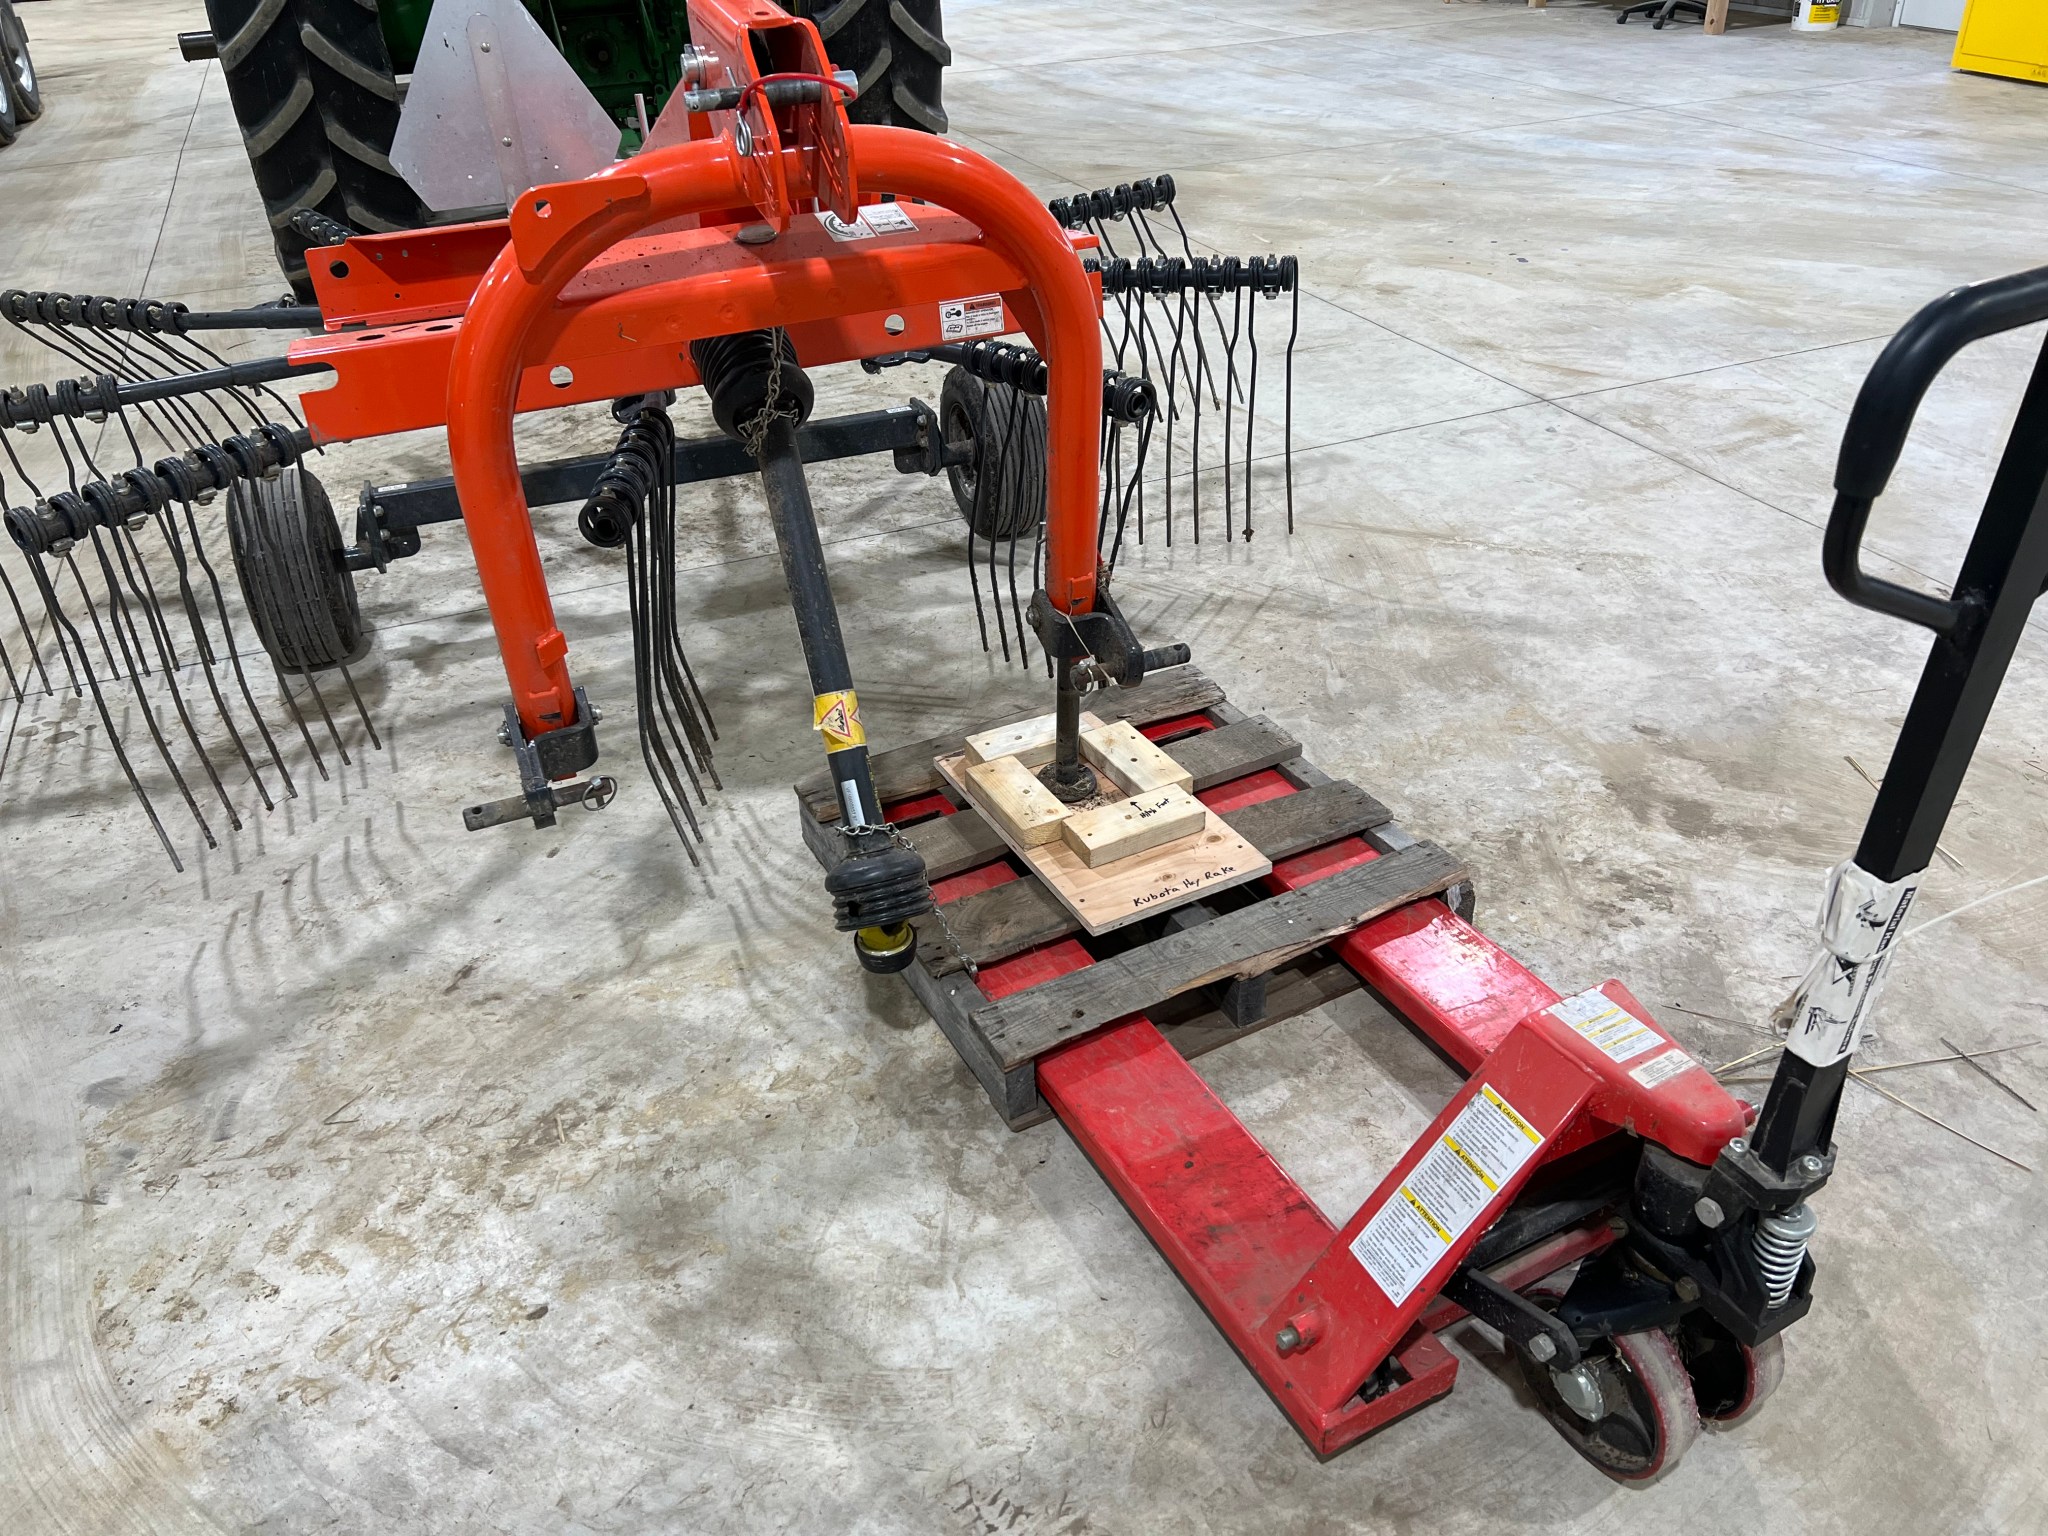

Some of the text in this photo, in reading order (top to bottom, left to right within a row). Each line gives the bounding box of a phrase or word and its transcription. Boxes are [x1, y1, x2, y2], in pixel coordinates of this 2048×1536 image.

[1133, 866, 1237, 907] Kubota Hay Rake
[1888, 890, 1915, 930] Material
[1501, 1106, 1526, 1130] CAUTION
[1459, 1152, 1486, 1180] ATENCIÓN
[1415, 1203, 1441, 1233] ATTENTION
